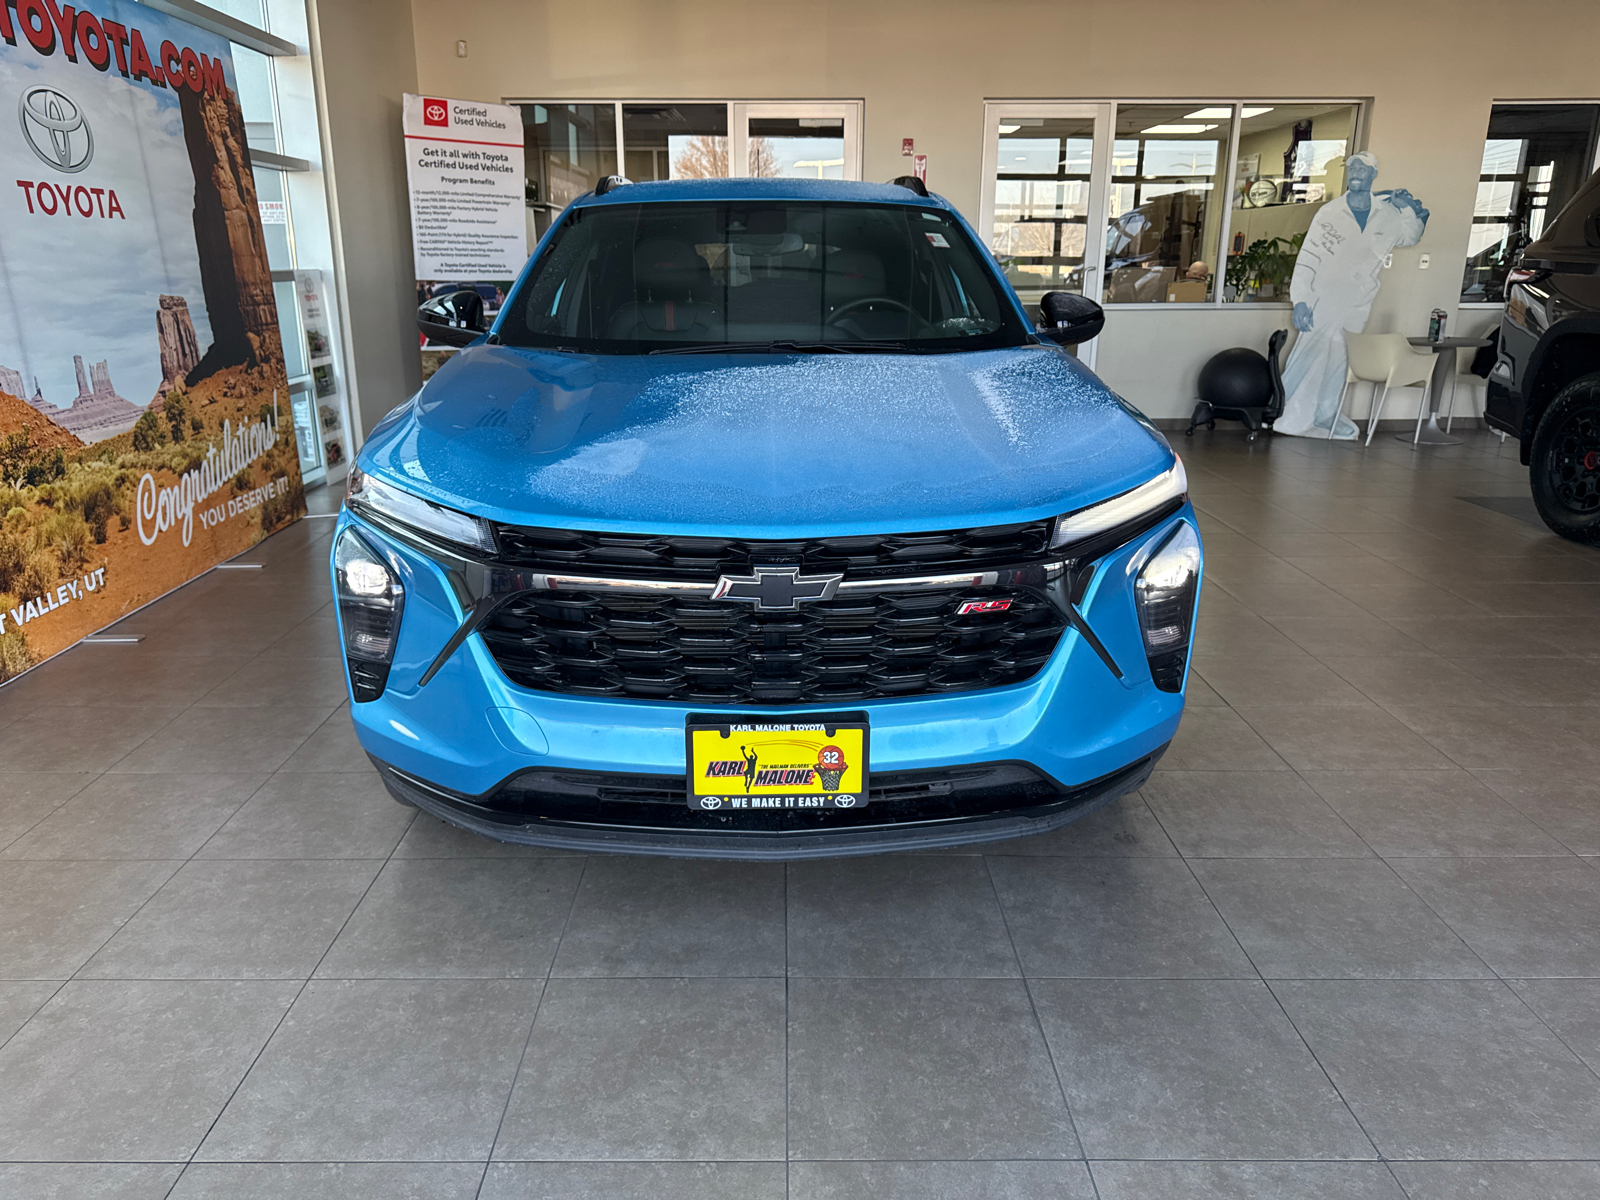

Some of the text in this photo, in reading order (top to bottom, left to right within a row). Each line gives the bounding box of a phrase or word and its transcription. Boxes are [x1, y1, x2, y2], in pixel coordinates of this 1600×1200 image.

[453, 106, 487, 117] Certified
[454, 116, 506, 129] Used Vehicles
[423, 148, 508, 163] Get it all with Toyota
[418, 159, 514, 173] Certified Used Vehicles
[441, 176, 495, 186] Program Benefits
[16, 180, 126, 220] TOYOTA
[136, 388, 280, 548] Congratulations!
[199, 476, 290, 530] YOU DESERVE IT!
[10, 579, 83, 627] VALLEY,
[83, 567, 105, 592] UT
[957, 599, 1013, 615] RS
[729, 723, 826, 732] KARL MALONE TOYOTA
[823, 751, 839, 764] 32
[705, 760, 745, 777] KARL
[754, 769, 814, 786] MALONE
[731, 796, 825, 808] WE MAKE IT EASY
